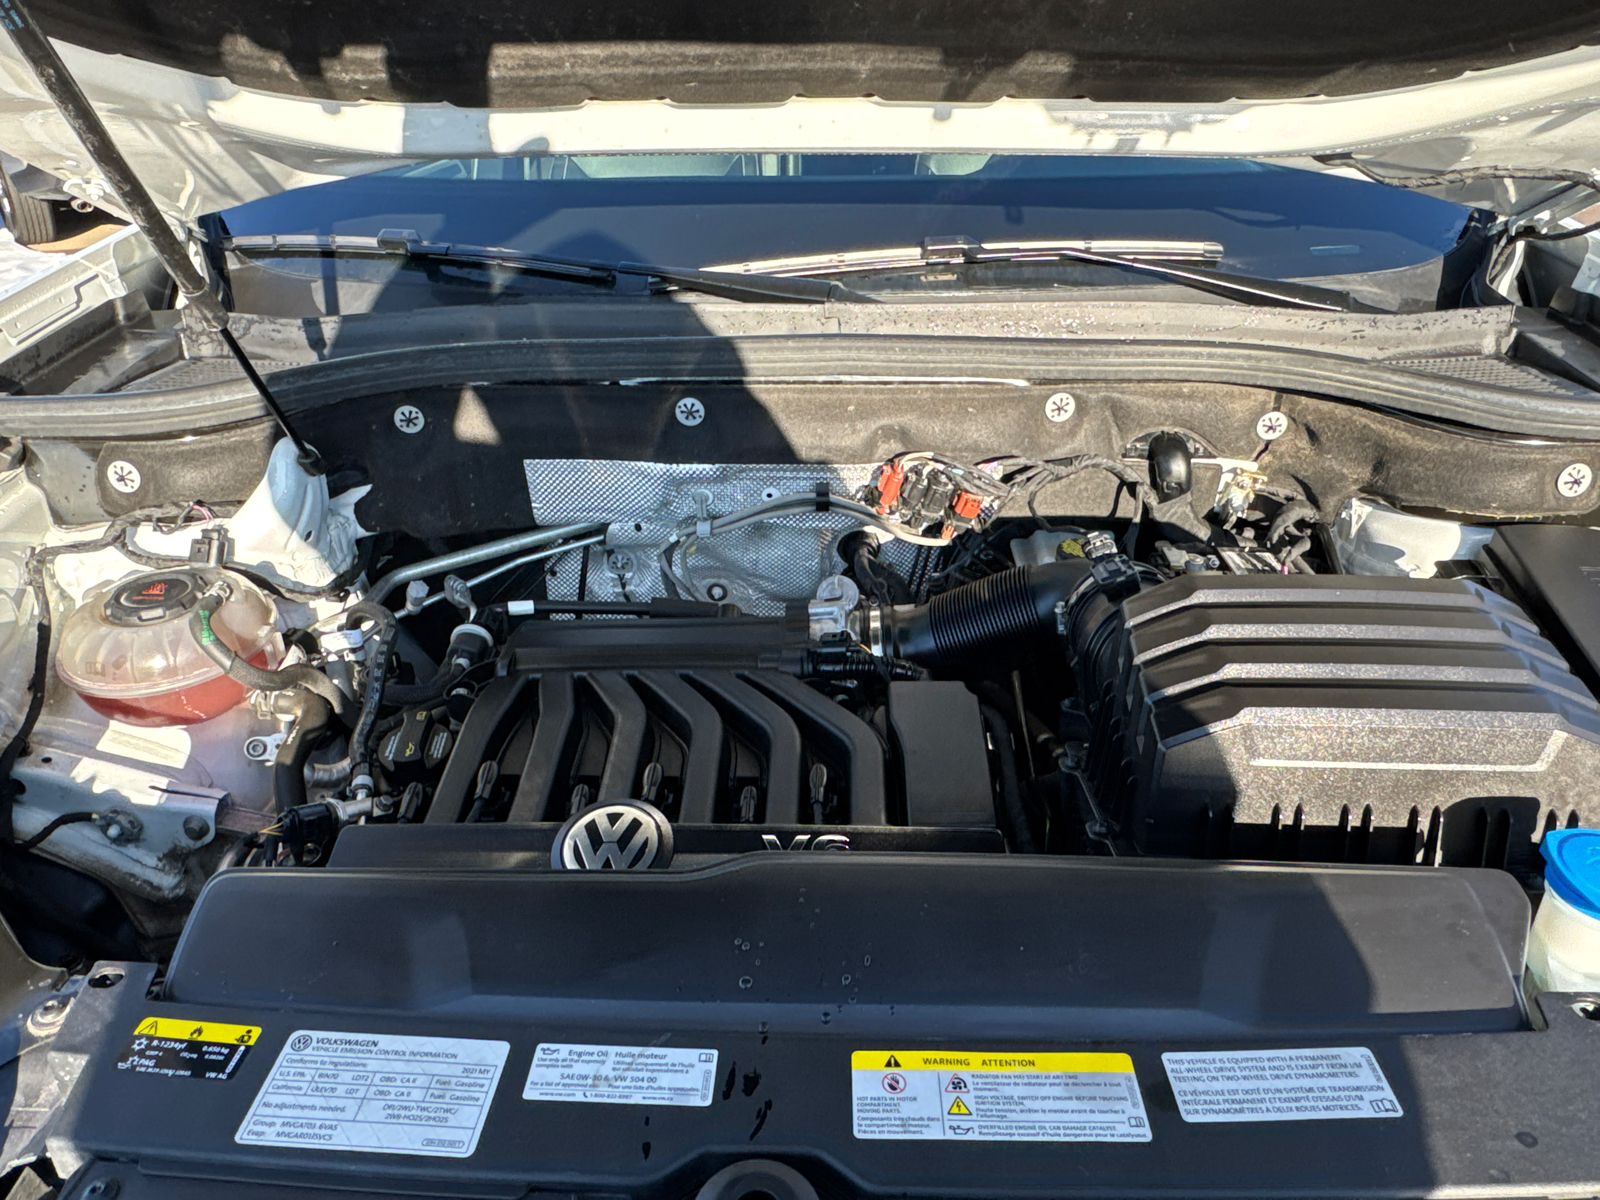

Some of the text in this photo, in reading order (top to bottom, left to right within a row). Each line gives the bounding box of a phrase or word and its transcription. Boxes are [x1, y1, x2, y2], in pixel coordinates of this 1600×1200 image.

[151, 1040, 188, 1051] R-1234yf
[316, 1038, 379, 1048] VOLKSWAGEN
[340, 1047, 373, 1055] EMISSION
[375, 1049, 407, 1057] CONTROL
[409, 1051, 458, 1060] INFORMATION
[568, 1050, 595, 1058] Engine
[615, 1051, 637, 1059] Huile
[286, 1057, 318, 1065] Conforms
[922, 1058, 1036, 1067] WARNING ATTENTION
[1167, 1058, 1185, 1066] THIS
[1227, 1057, 1265, 1065] EQUIPPED
[1297, 1054, 1342, 1062] PERMANENT
[462, 1067, 491, 1076] 2021 MY
[1170, 1066, 1213, 1074] ALL-WHEEL
[1326, 1062, 1348, 1070] FROM
[560, 1073, 575, 1081] SAE
[646, 1076, 658, 1084] 00
[1173, 1075, 1206, 1083] TESTING
[455, 1080, 486, 1089] Gasoline
[374, 1089, 392, 1097] OBD:
[1189, 1088, 1226, 1097] VÉHICULE
[1241, 1087, 1262, 1096] DOTÉ
[1328, 1085, 1385, 1093] TRANSMISSION
[450, 1094, 481, 1102] Gasoline
[1181, 1098, 1221, 1106] INTÉGRALE
[1223, 1098, 1267, 1106] PERMANENT
[273, 1102, 318, 1112] adjustments
[318, 1105, 346, 1113] needed.
[1201, 1106, 1265, 1115] DYNAMOMÈTRES
[253, 1119, 277, 1128] Group:
[247, 1129, 266, 1137] Evap:
